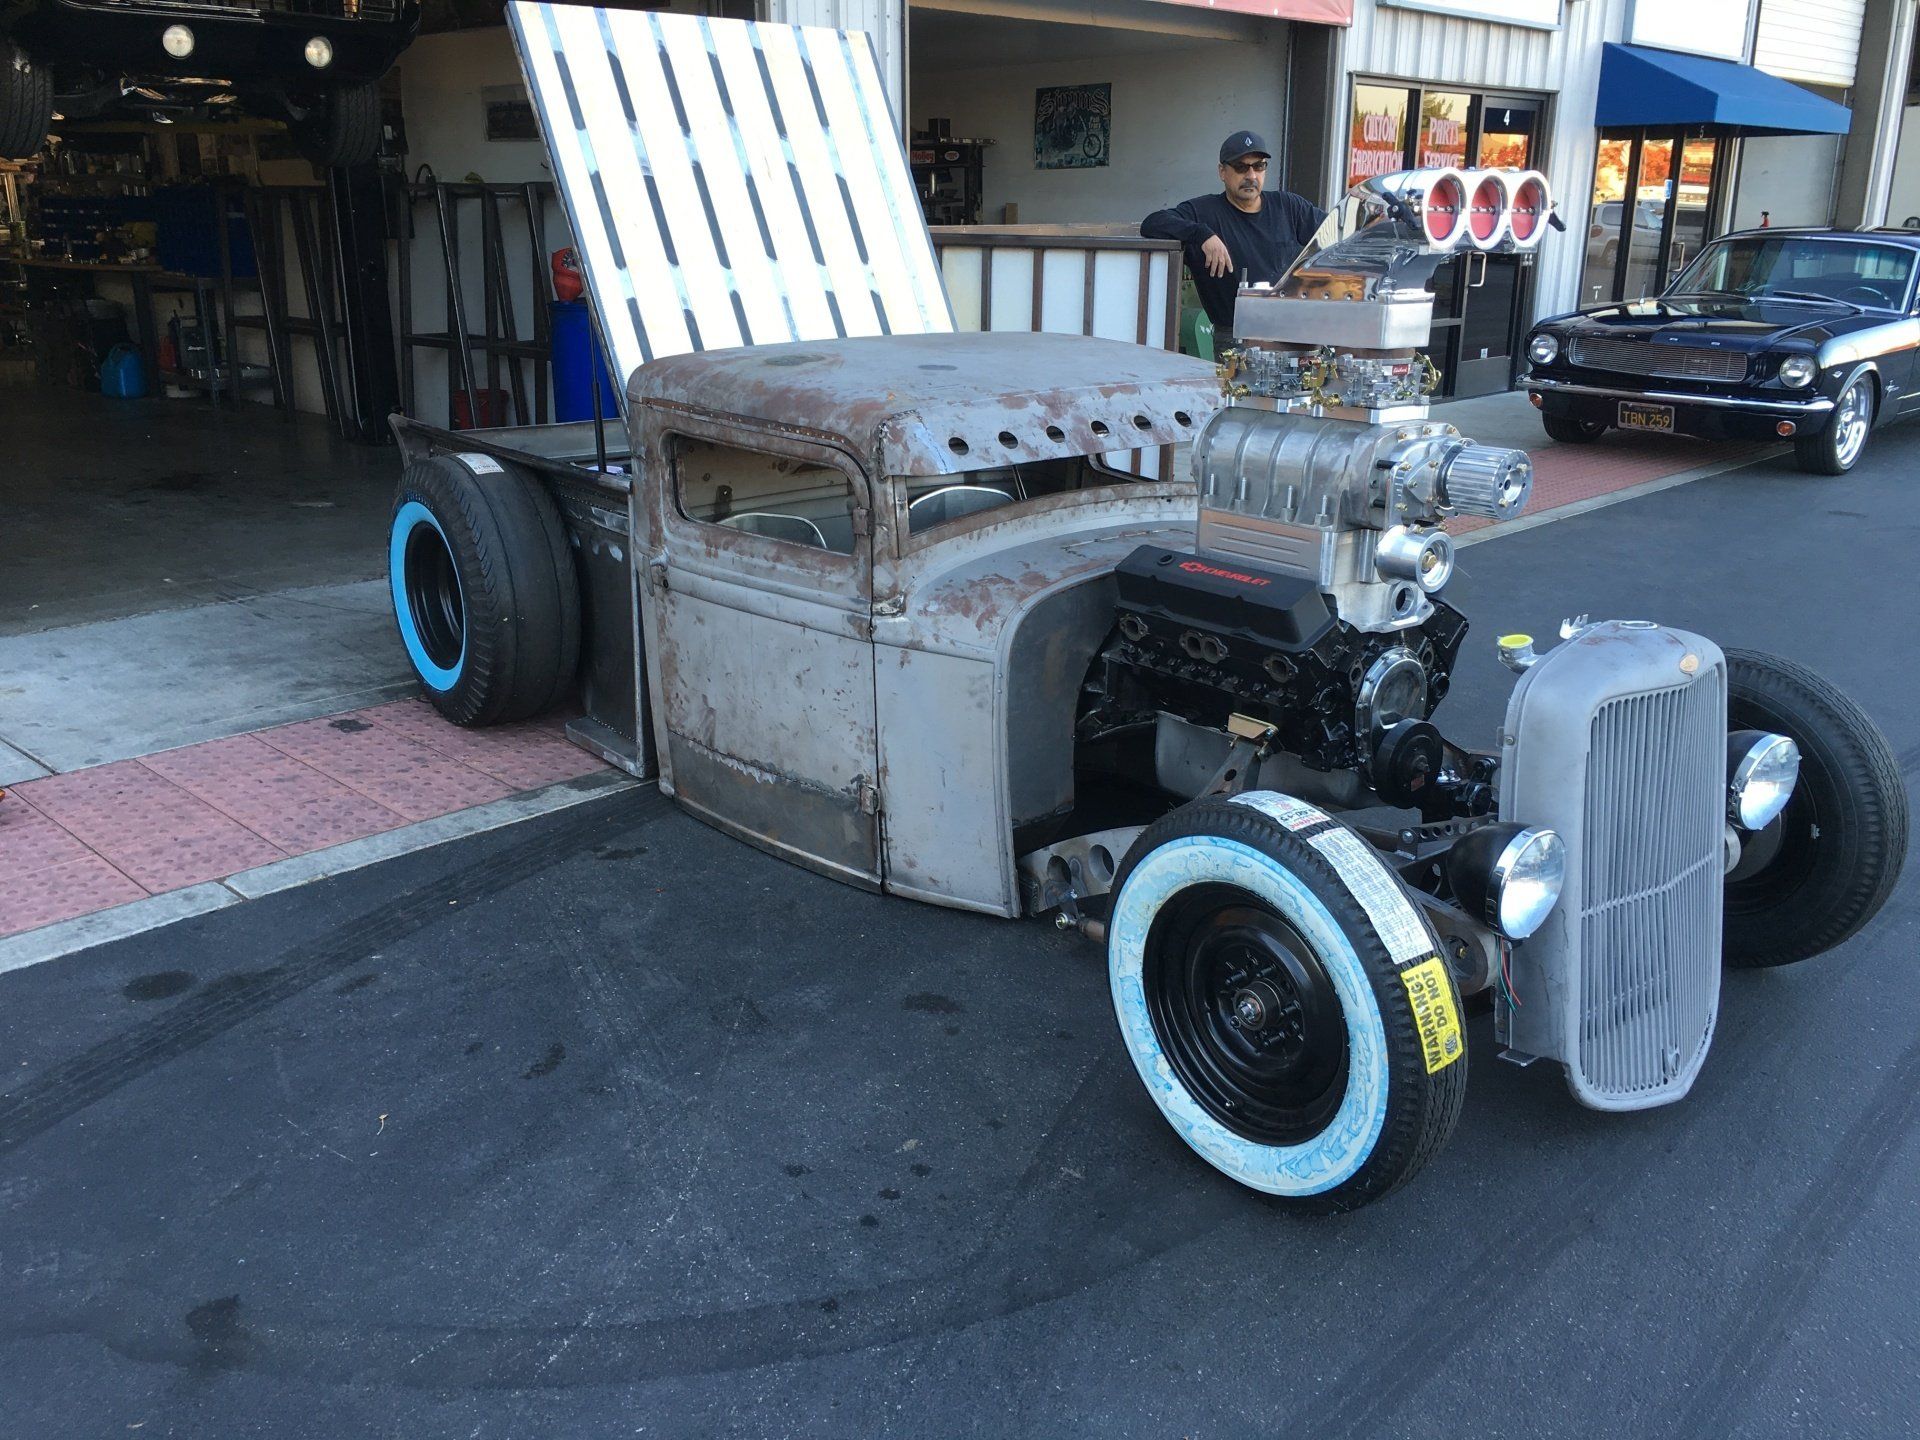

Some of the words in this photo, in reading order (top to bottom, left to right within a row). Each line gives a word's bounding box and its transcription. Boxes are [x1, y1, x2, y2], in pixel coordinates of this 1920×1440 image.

[1363, 114, 1398, 143] CUSTOM
[1427, 116, 1460, 146] PARTS
[1503, 109, 1511, 126] 4
[1350, 147, 1404, 178] FABRICATION
[1623, 411, 1646, 426] TBN
[1647, 414, 1671, 429] 259
[1202, 566, 1271, 586] CHEVROLET
[1422, 970, 1441, 1000] NOT
[1405, 973, 1442, 1068] WARNING!
[1434, 1004, 1447, 1029] DO
